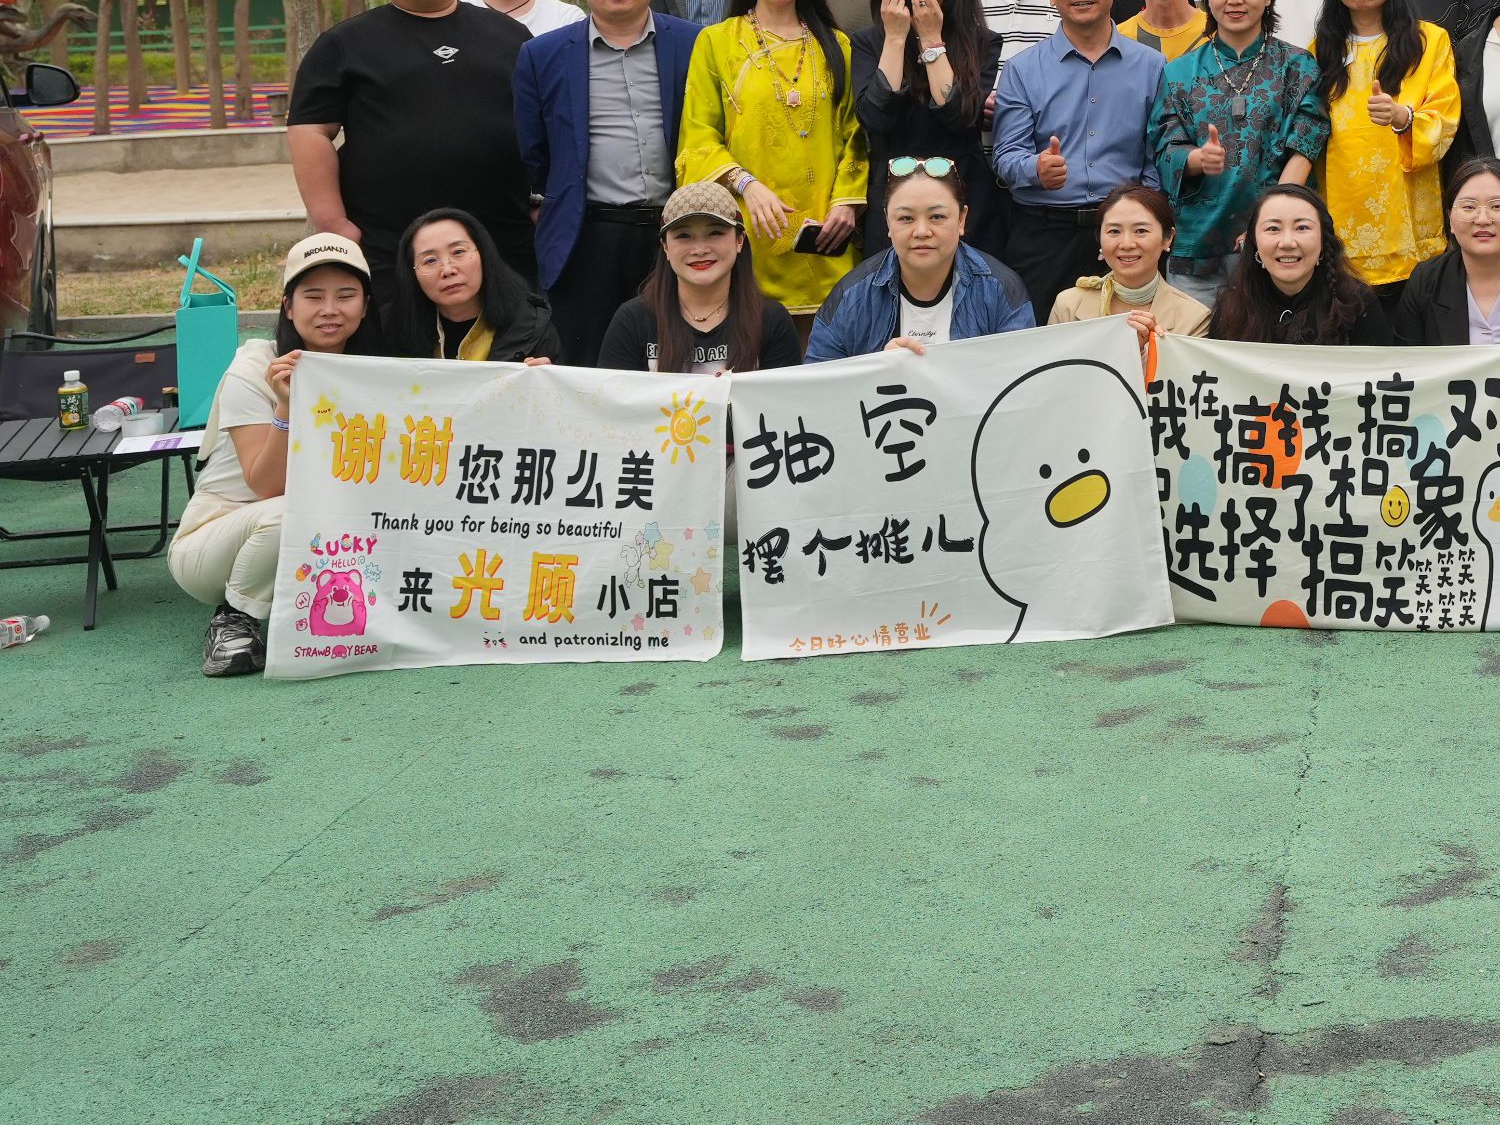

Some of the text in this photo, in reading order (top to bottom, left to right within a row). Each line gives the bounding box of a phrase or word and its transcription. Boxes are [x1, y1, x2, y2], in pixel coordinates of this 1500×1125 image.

[742, 384, 938, 490] 抽空
[371, 511, 622, 539] Thank you for being so beautiful
[310, 533, 378, 556] LUCKY
[742, 514, 974, 584] 摆个摊儿
[331, 558, 356, 569] HELLO
[519, 631, 547, 645] and
[648, 635, 669, 647] me
[789, 622, 931, 652] 今日好心情营业
[355, 644, 378, 656] BEAR
